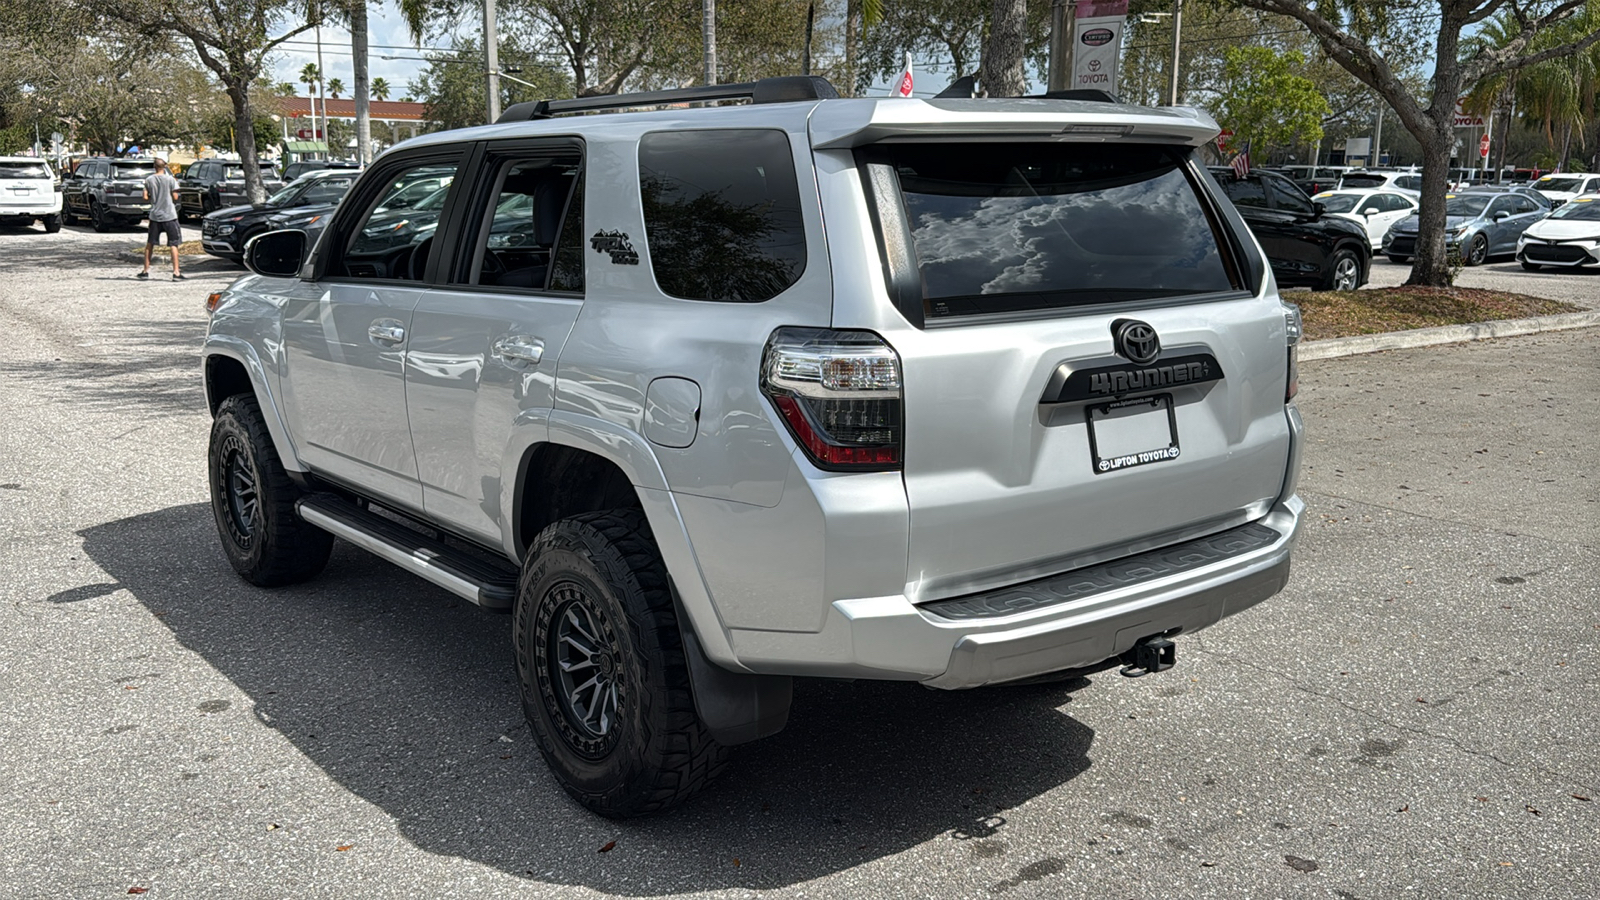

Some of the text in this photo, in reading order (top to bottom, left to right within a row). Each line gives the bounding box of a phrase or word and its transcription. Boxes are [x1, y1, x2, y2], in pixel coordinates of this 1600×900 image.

[1078, 74, 1108, 84] TOYOTA
[1454, 118, 1483, 126] OYOTA
[1089, 362, 1203, 394] 4RUNNER
[1110, 449, 1169, 468] LIPTON TOYOTA
